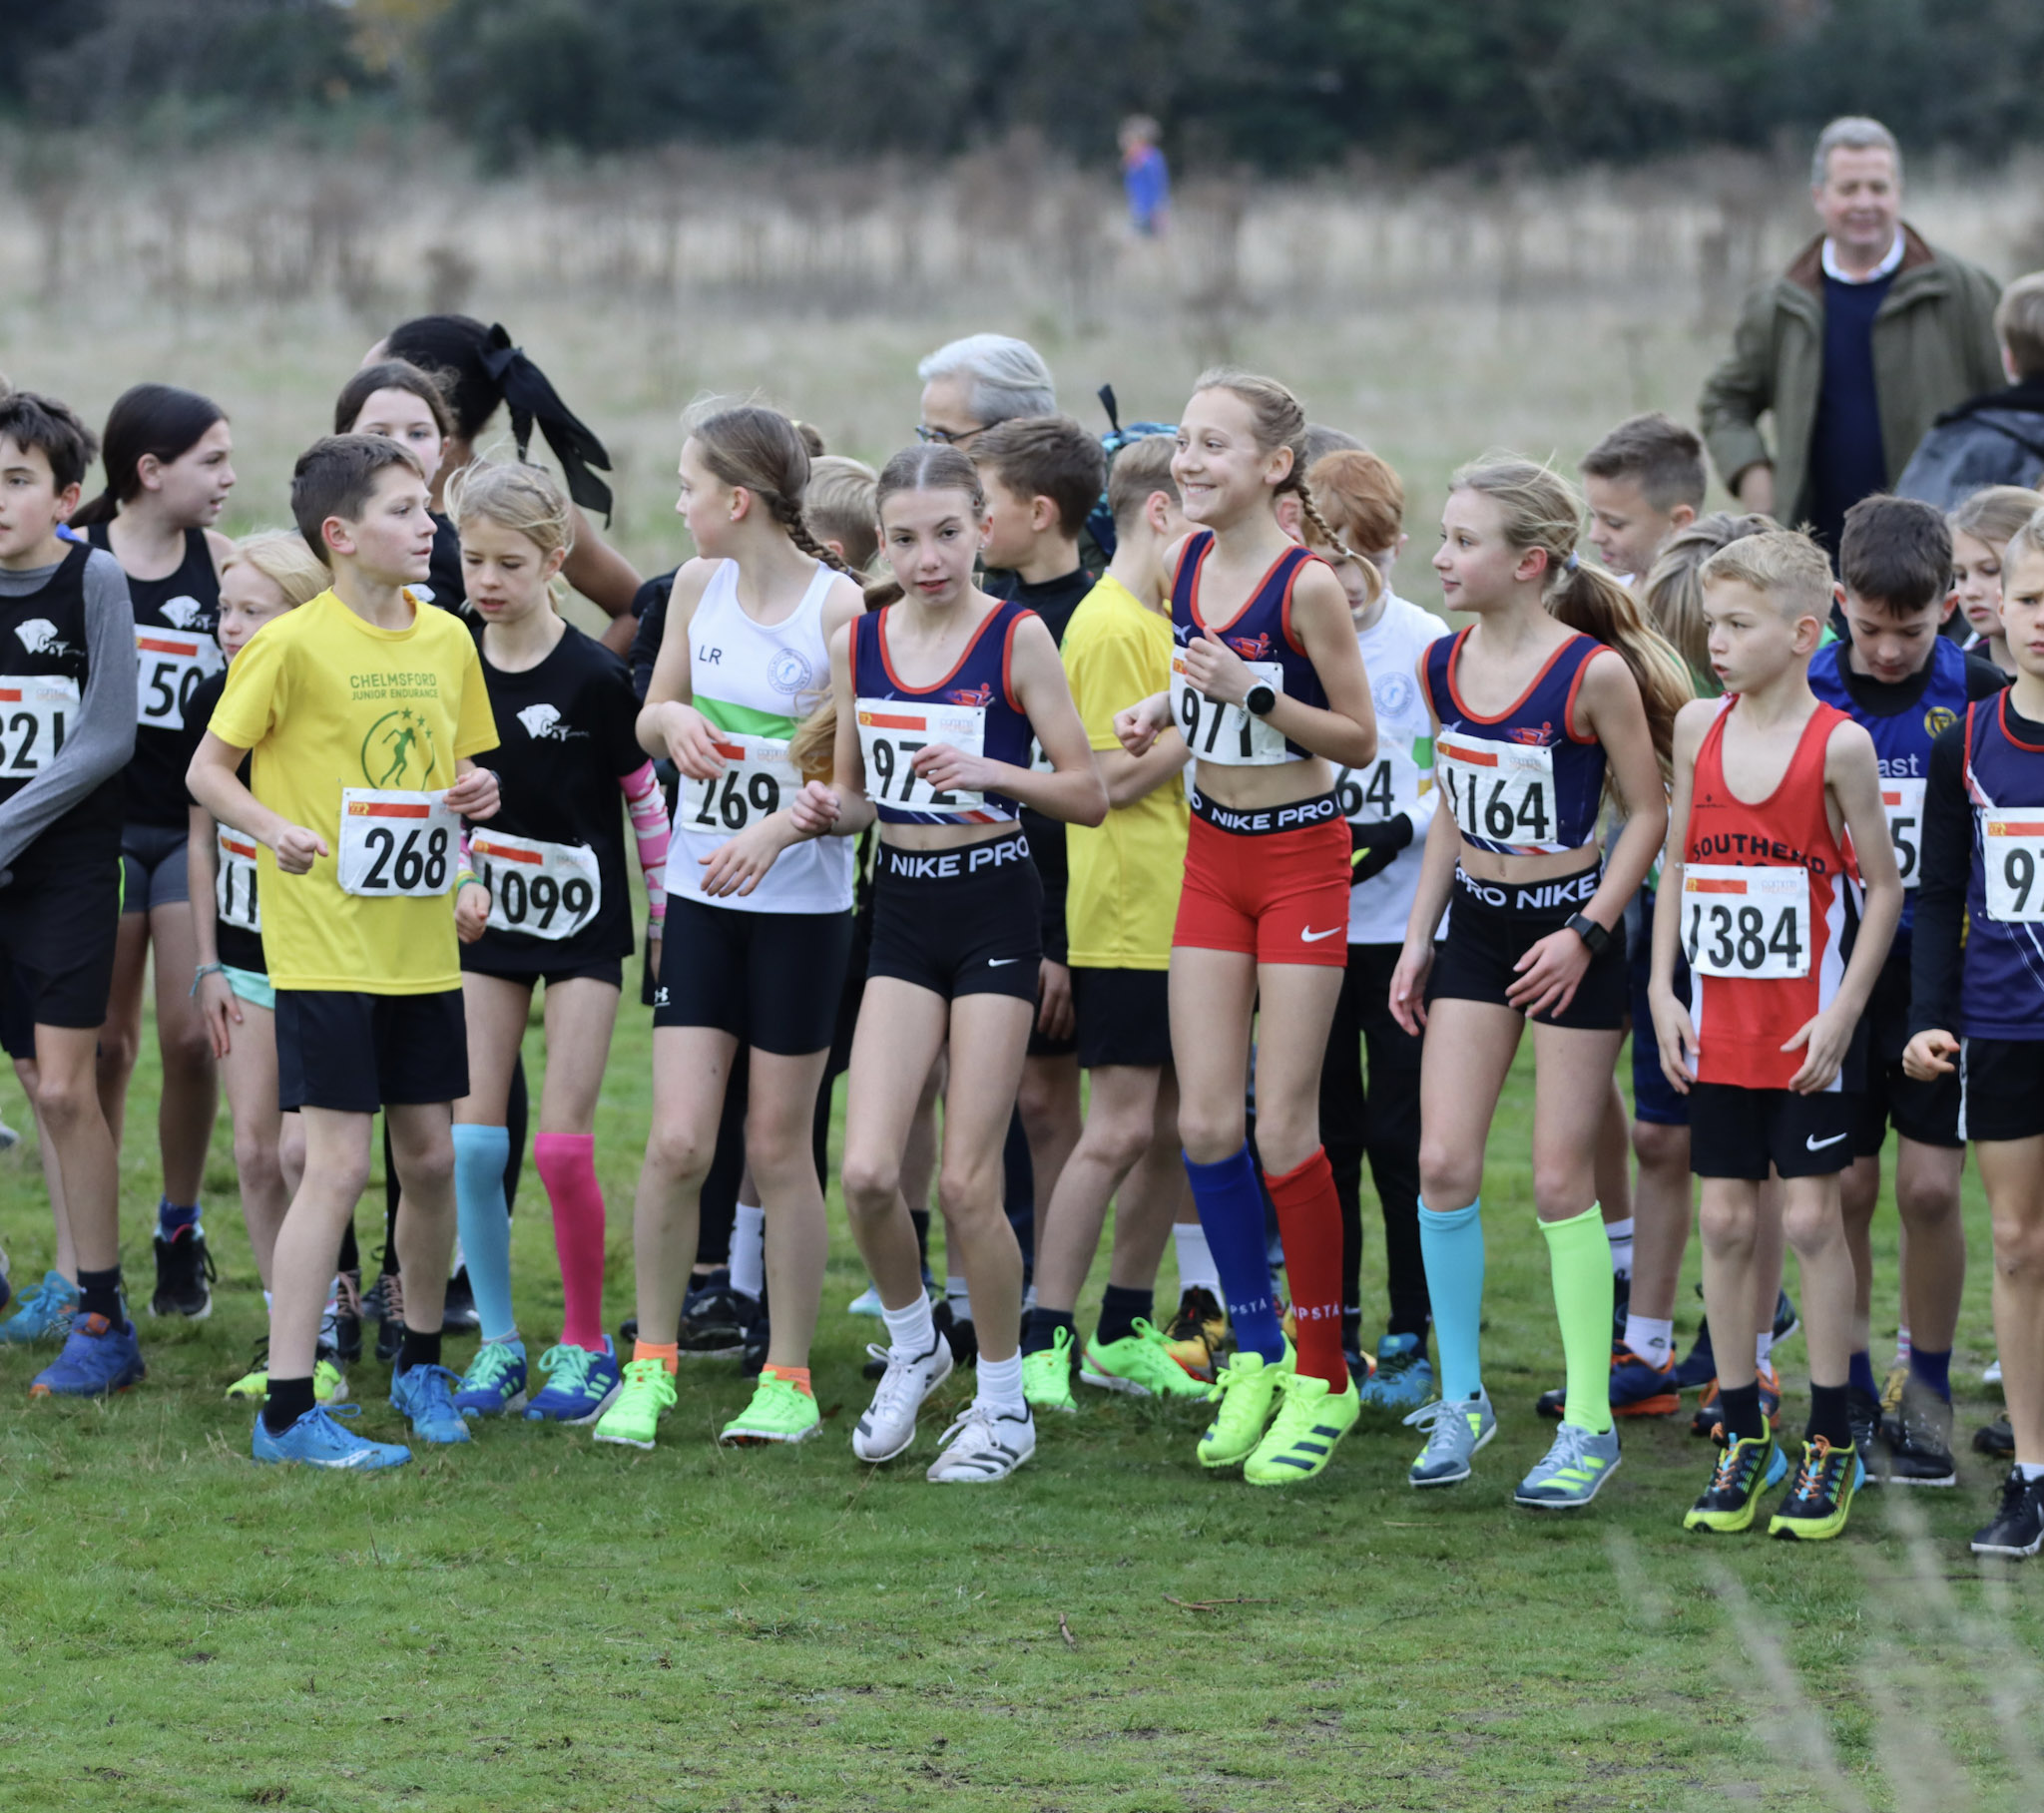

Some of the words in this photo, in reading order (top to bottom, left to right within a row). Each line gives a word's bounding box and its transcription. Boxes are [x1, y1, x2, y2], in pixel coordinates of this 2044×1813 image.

[350, 673, 437, 688] CHELMSFORD
[699, 645, 723, 666] LR
[138, 659, 205, 717] 50
[352, 688, 387, 700] JUNIOR
[390, 687, 439, 698] ENDURANCE
[0, 711, 65, 769] 21
[1182, 686, 1253, 758] 971
[696, 769, 779, 830] 269
[872, 738, 957, 805] 97
[1211, 807, 1271, 831] NIKE
[1278, 799, 1333, 827] PRO
[1447, 766, 1550, 840] 1164
[360, 826, 448, 890] 268
[890, 852, 961, 879] NIKE
[969, 834, 1030, 873] PRO
[2004, 848, 2044, 913] 9
[483, 861, 594, 931] 1099
[1455, 866, 1507, 907] PRO
[1516, 871, 1598, 910] NIKE
[1689, 904, 1802, 970] 1384
